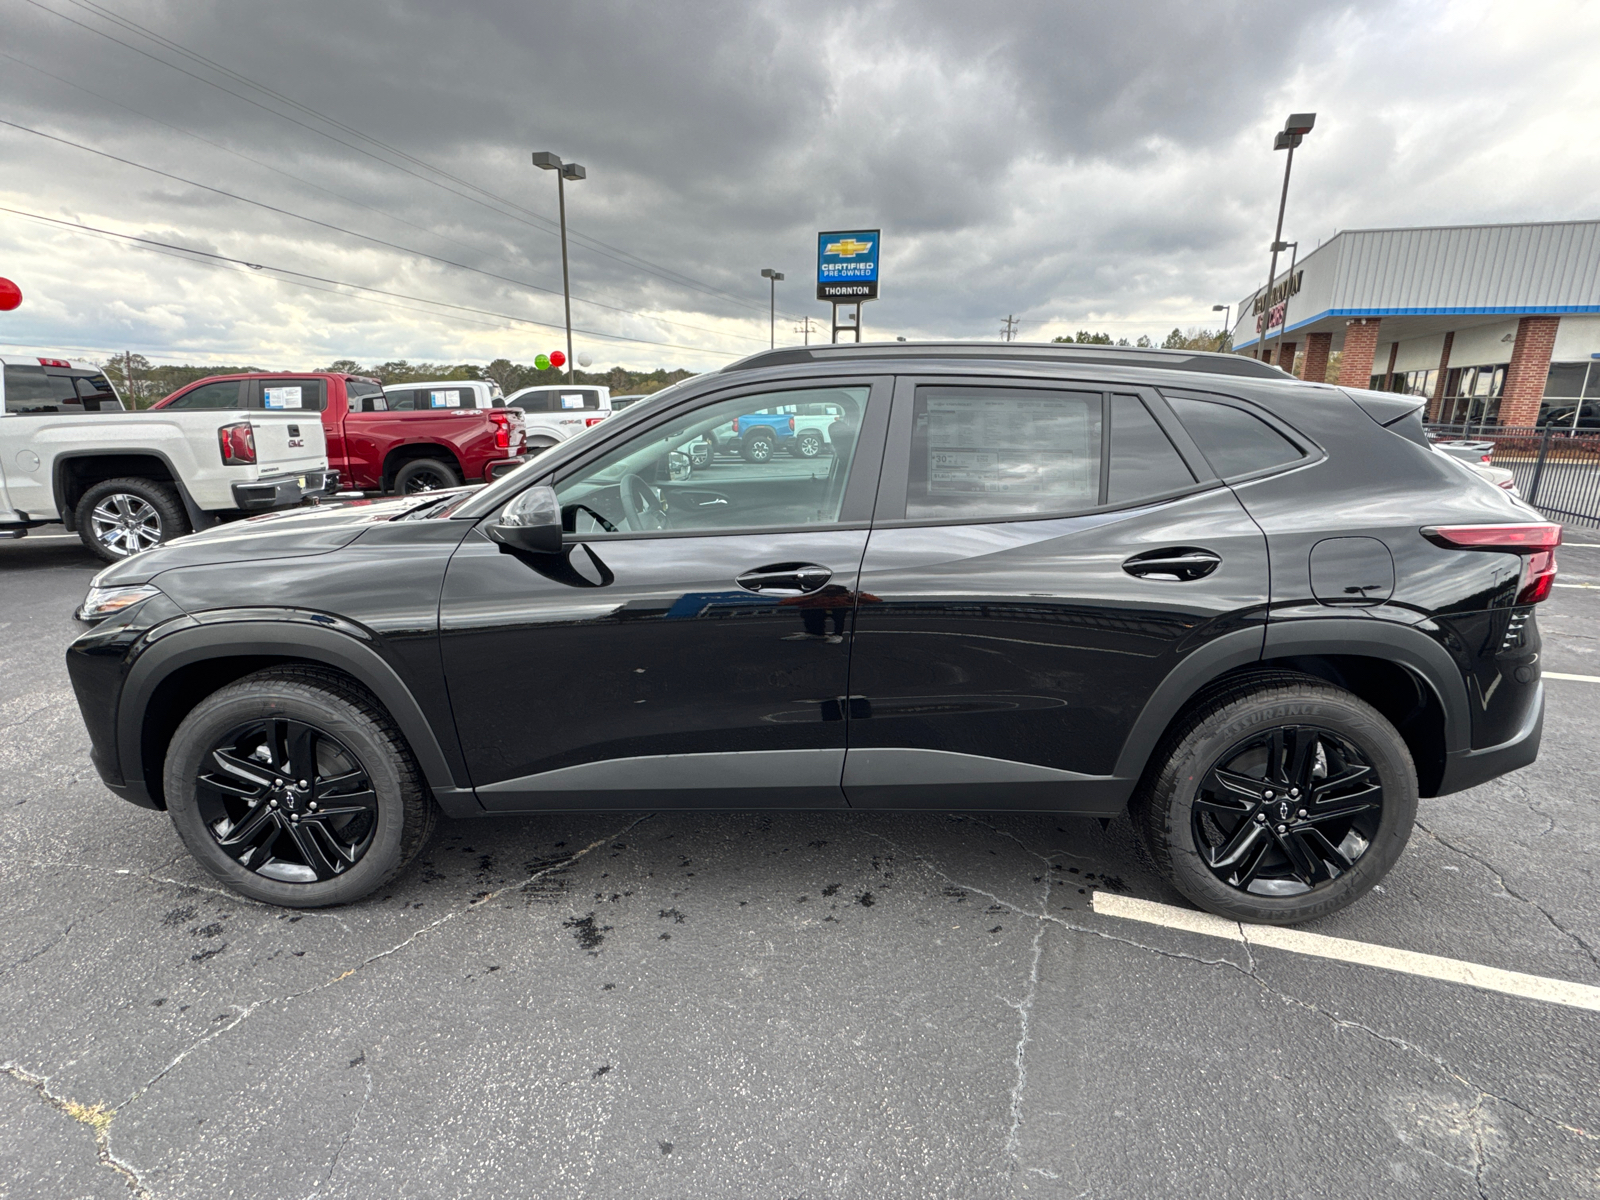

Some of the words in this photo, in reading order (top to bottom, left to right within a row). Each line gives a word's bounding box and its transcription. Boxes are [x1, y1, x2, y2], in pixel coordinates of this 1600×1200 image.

[821, 262, 874, 271] CERTIFIED
[823, 269, 871, 277] PRE-OWNED
[825, 286, 869, 295] THORNTON
[288, 439, 304, 448] GMC
[936, 455, 947, 463] 30
[1223, 704, 1321, 740] ASSURANCE
